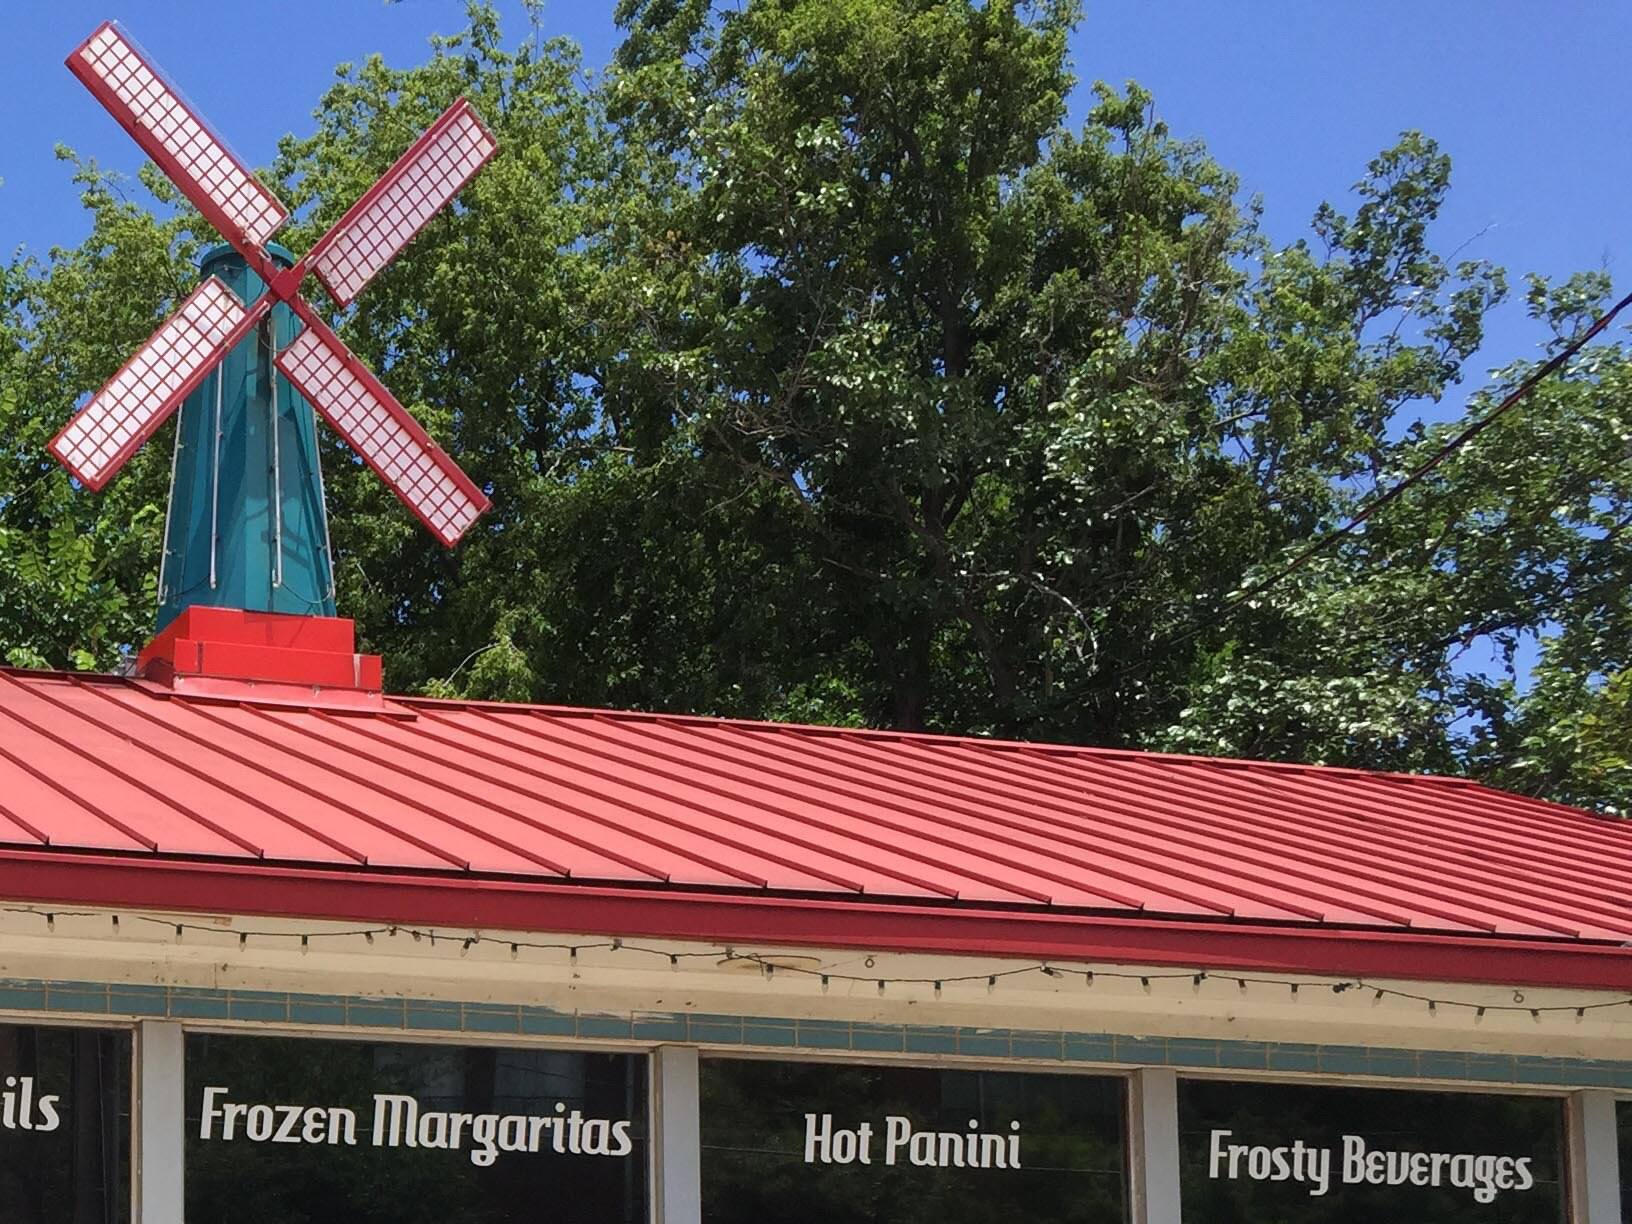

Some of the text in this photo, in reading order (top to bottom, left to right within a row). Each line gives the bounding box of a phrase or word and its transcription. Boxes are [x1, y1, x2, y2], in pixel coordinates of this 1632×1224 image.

[199, 1086, 633, 1167] Frozen Margaritas
[804, 1113, 1021, 1169] Hot Panini
[1209, 1129, 1533, 1204] Frosty Beverages
